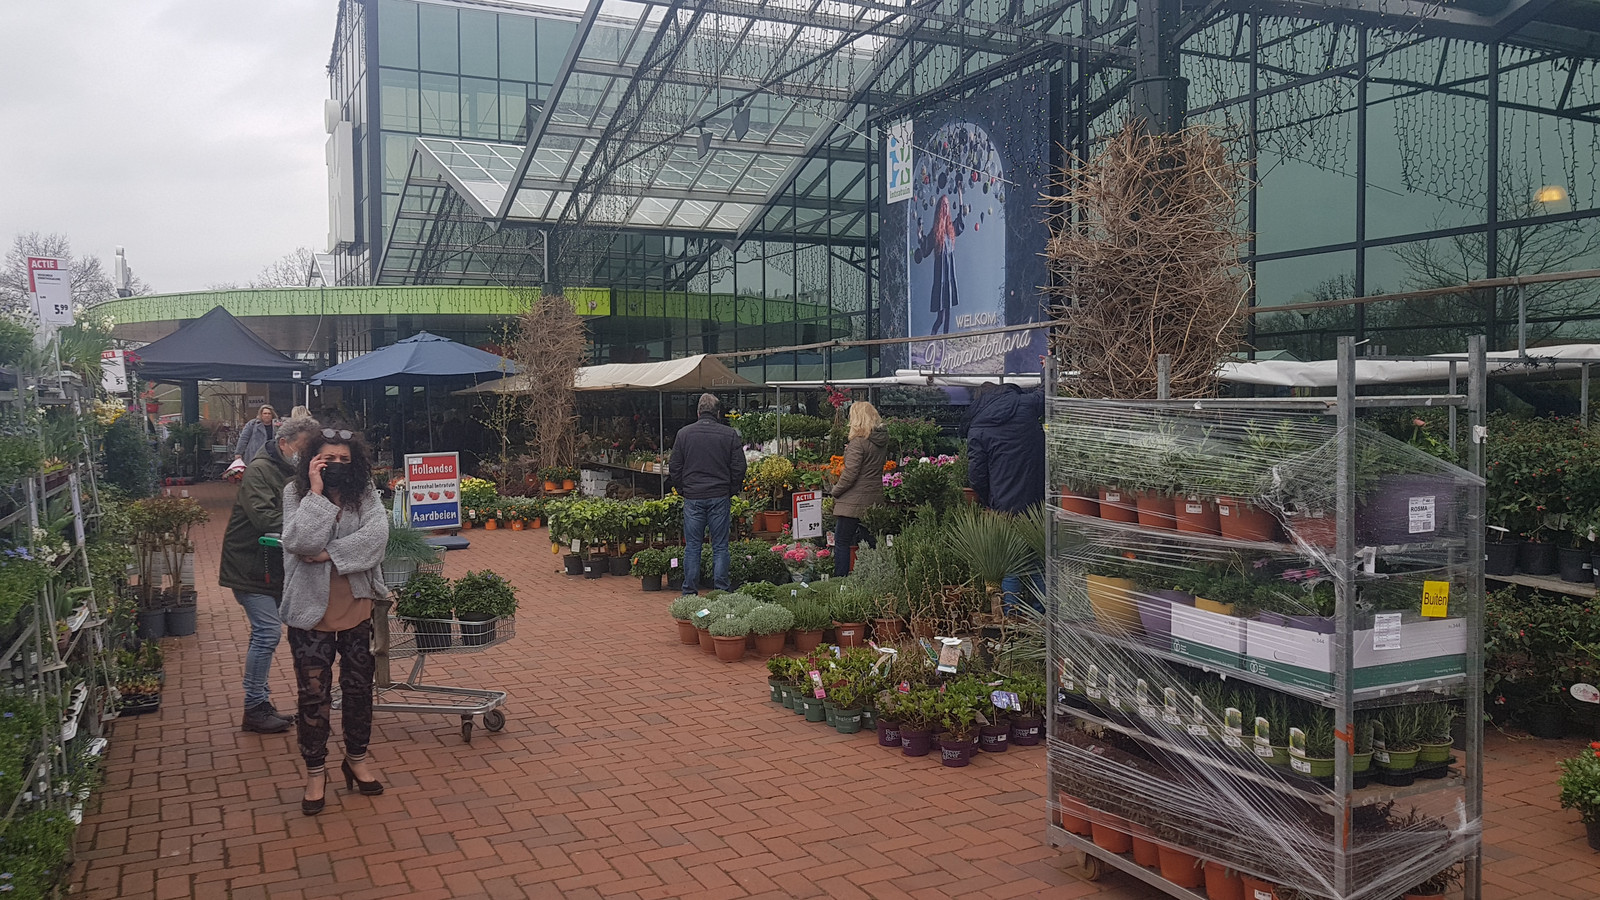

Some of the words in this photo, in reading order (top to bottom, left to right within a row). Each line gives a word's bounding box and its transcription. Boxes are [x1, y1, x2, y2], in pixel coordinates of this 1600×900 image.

[31, 260, 55, 269] ACTIE
[54, 304, 69, 315] 5.99
[955, 312, 997, 328] WELKOM
[412, 463, 454, 475] Hollandse
[796, 493, 813, 502] ACTIE
[1410, 505, 1428, 513] ROSMA
[412, 510, 457, 522] Aardbeien
[809, 522, 820, 531] 5.99
[1424, 592, 1447, 606] Buiten
